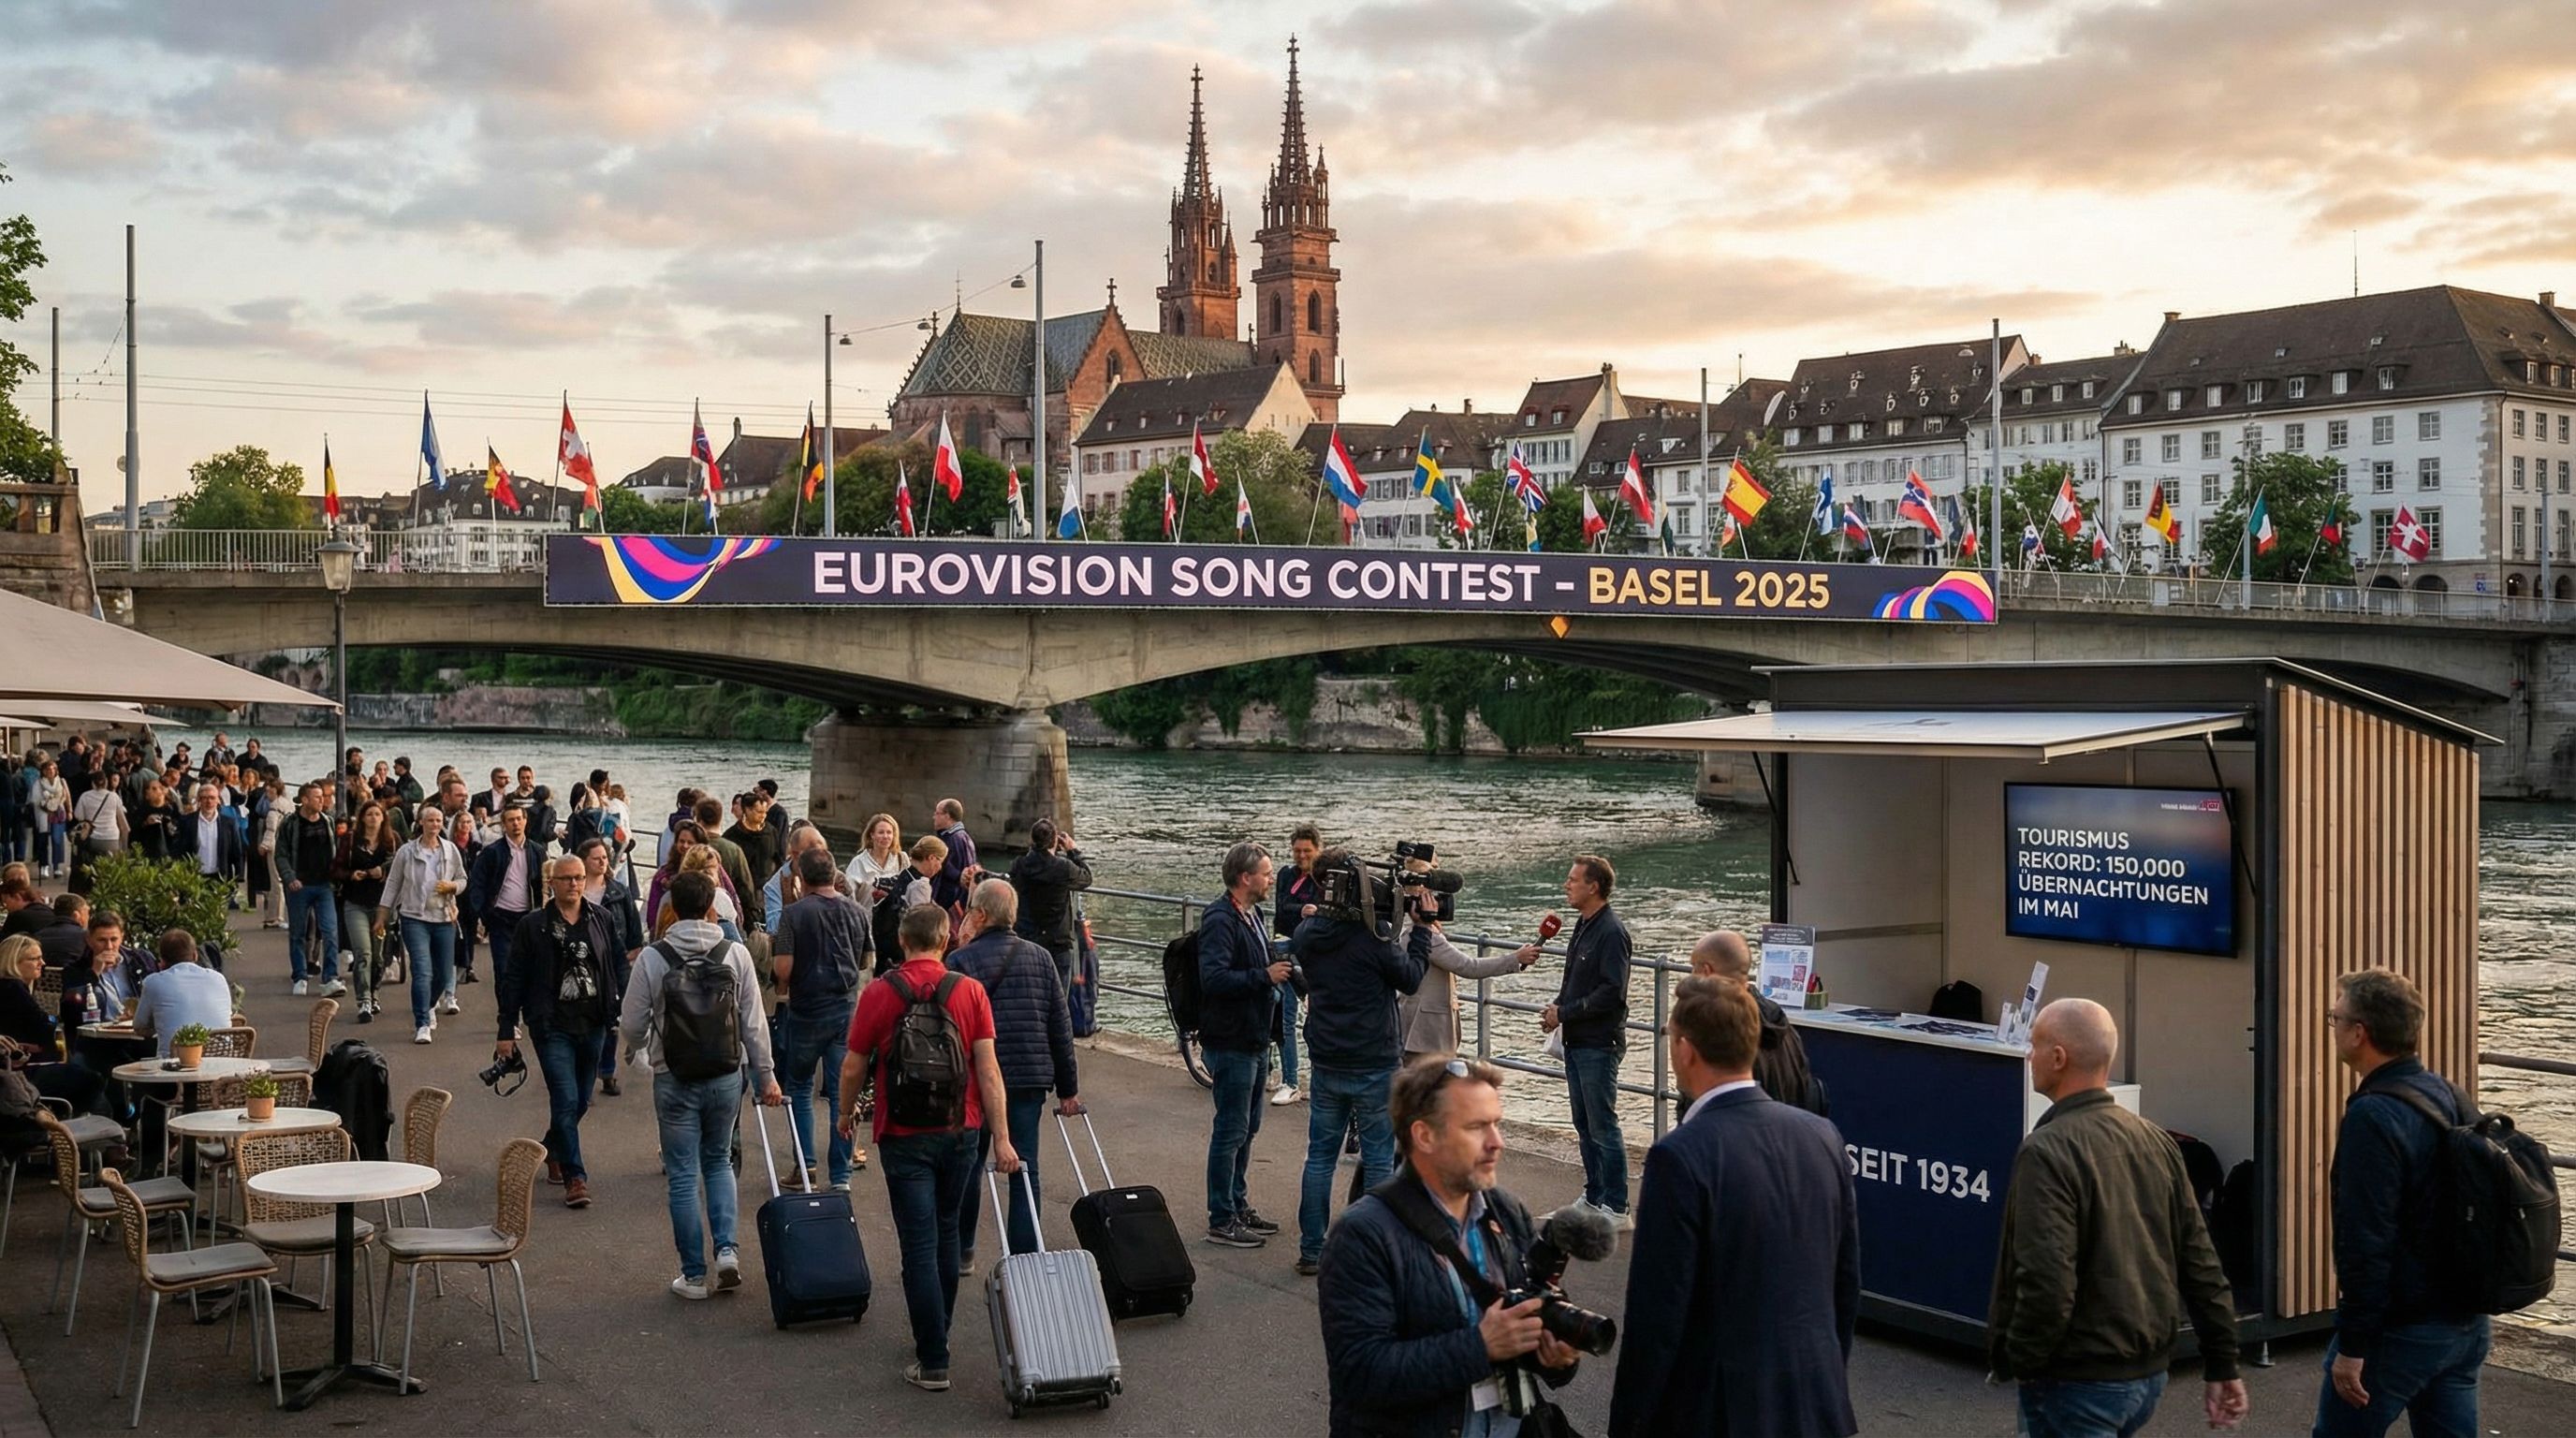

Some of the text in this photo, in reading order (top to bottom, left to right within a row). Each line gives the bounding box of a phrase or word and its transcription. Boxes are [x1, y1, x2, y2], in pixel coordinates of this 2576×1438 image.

[813, 551, 1152, 596] EUROVISION
[1170, 556, 1312, 599] SONG
[1327, 559, 1542, 602] CONTEST
[1589, 566, 1723, 608] BASEL
[1734, 570, 1831, 609] 2025
[2017, 828, 2130, 849] TOURISMUS
[2018, 850, 2186, 878] REKORD: 150,000
[2018, 869, 2209, 905] ÜBERNACHTUNGEN
[2018, 897, 2079, 919] IM MAI
[1845, 1143, 1991, 1203] SEIT 1934
